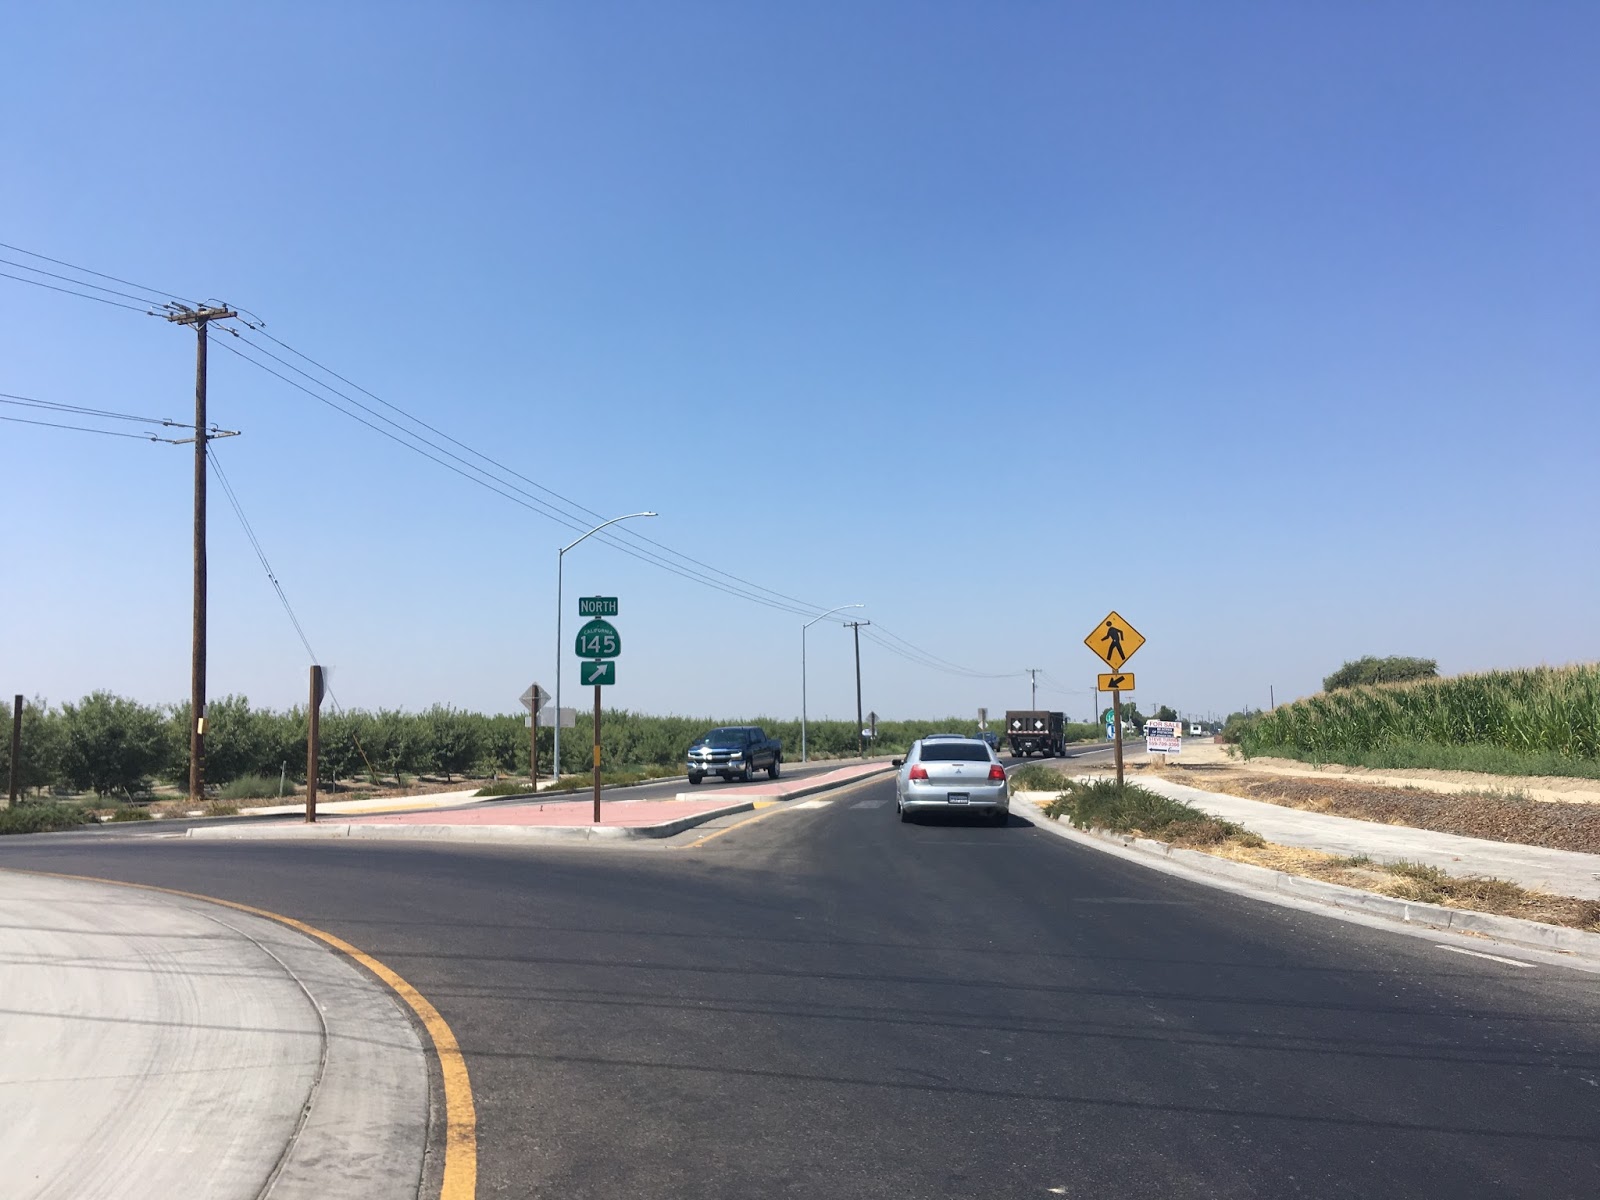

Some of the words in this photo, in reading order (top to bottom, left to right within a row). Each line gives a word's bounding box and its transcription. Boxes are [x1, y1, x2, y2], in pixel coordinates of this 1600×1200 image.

[581, 600, 616, 612] NORTH
[580, 635, 616, 653] 145
[1163, 721, 1180, 729] SALE
